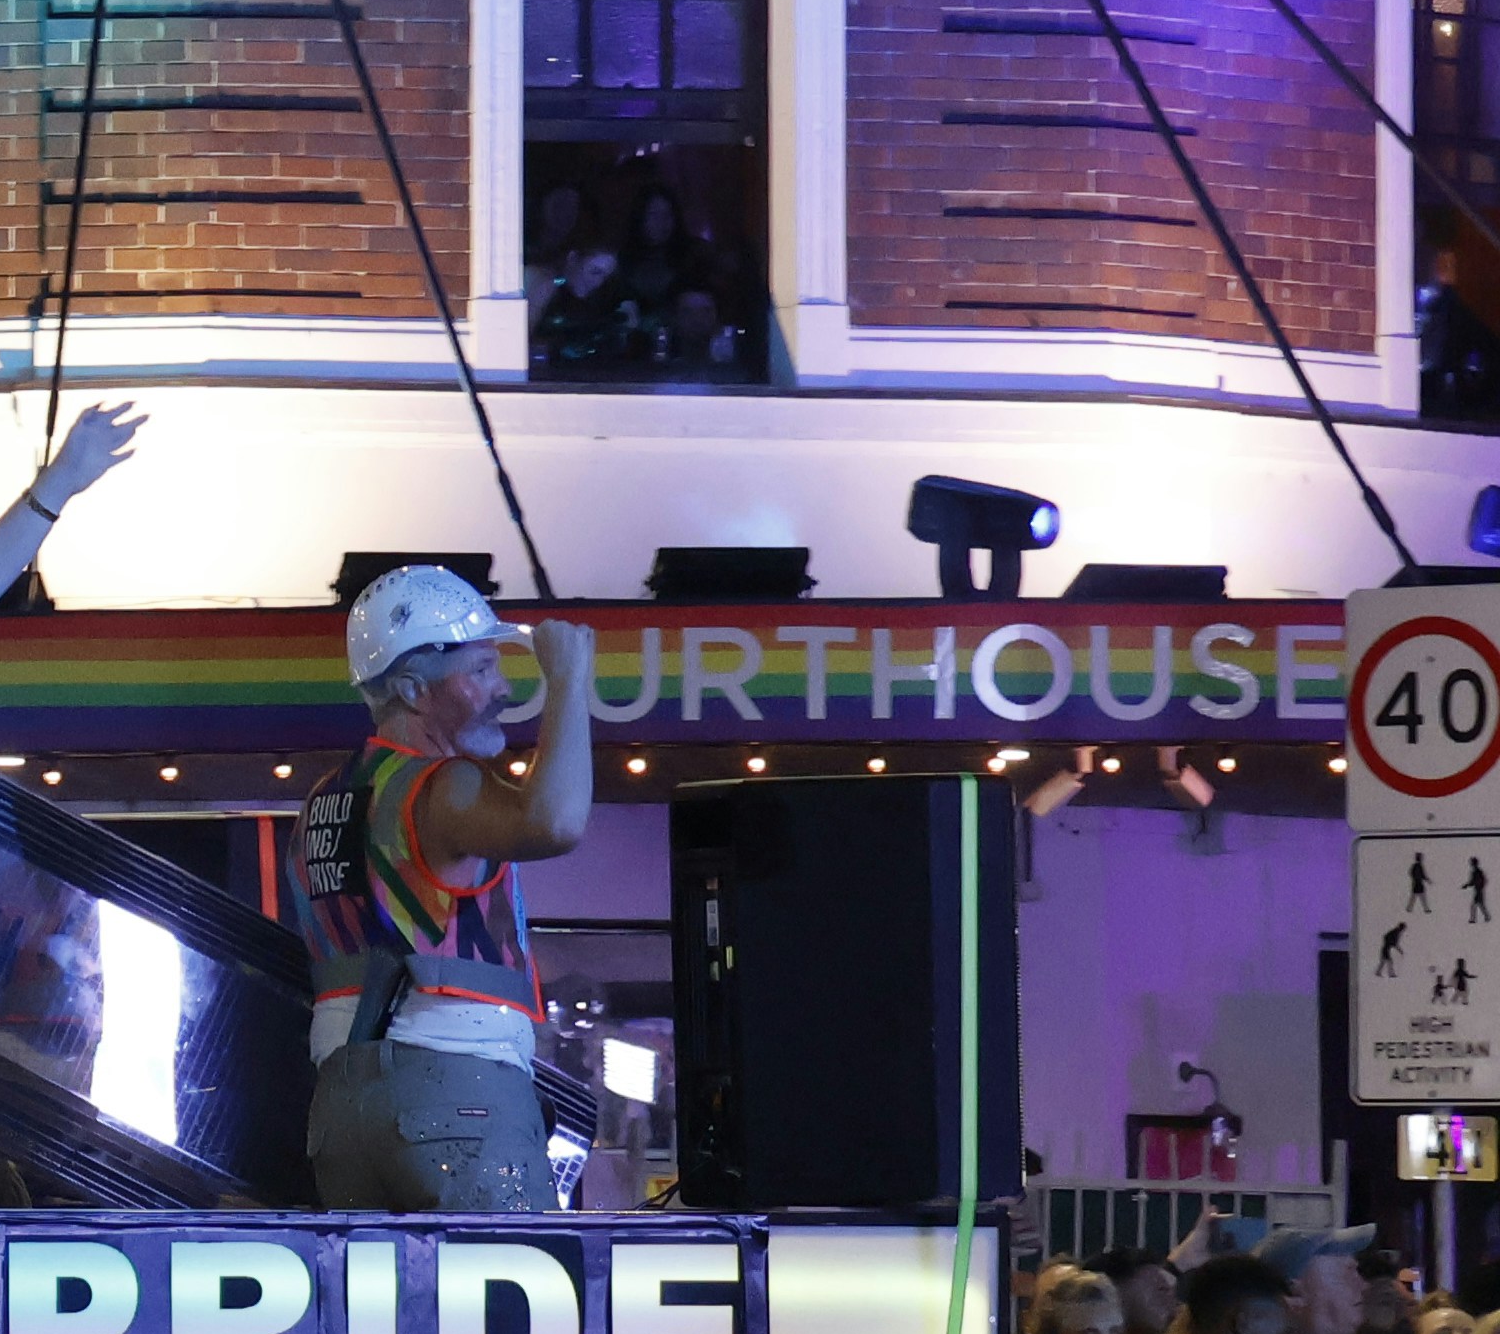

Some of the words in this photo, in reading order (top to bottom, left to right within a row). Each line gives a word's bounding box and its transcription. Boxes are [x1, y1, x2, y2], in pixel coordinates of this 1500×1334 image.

[1375, 669, 1487, 744] 40
[308, 792, 354, 826] BUILD
[1373, 1040, 1491, 1059] PEDESTRIAN
[1390, 1065, 1474, 1084] ACTIVITY
